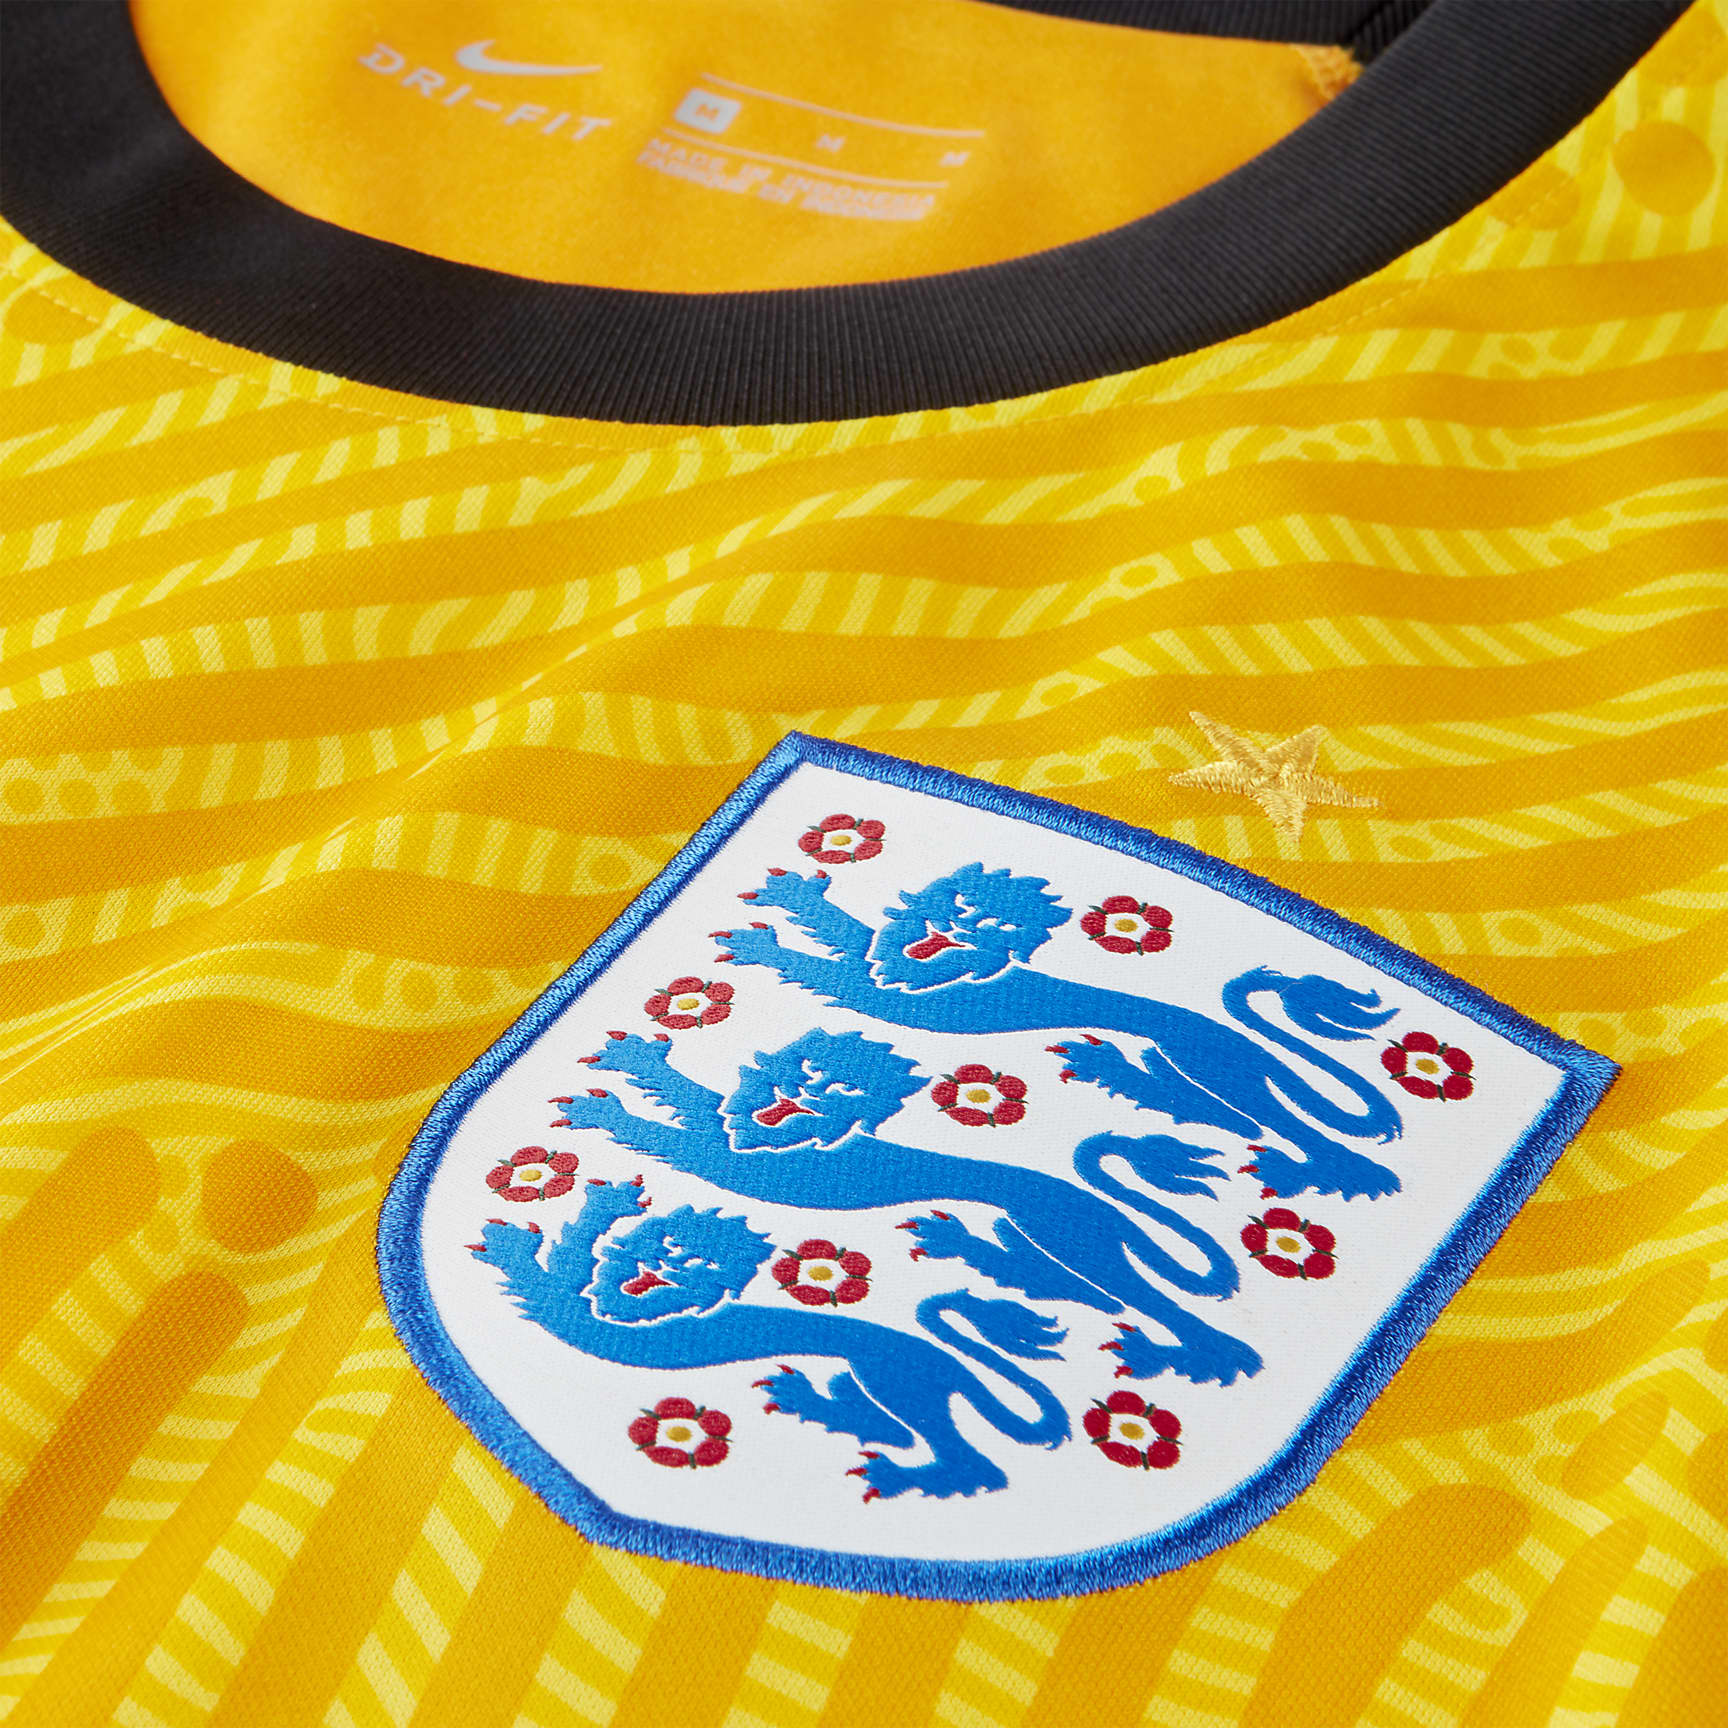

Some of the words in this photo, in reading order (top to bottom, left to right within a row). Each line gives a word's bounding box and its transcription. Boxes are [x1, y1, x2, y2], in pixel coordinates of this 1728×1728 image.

[358, 42, 612, 140] DRI-FIT
[694, 102, 720, 120] M
[645, 137, 728, 170] MADE
[737, 163, 773, 181] IN
[816, 133, 846, 153] M
